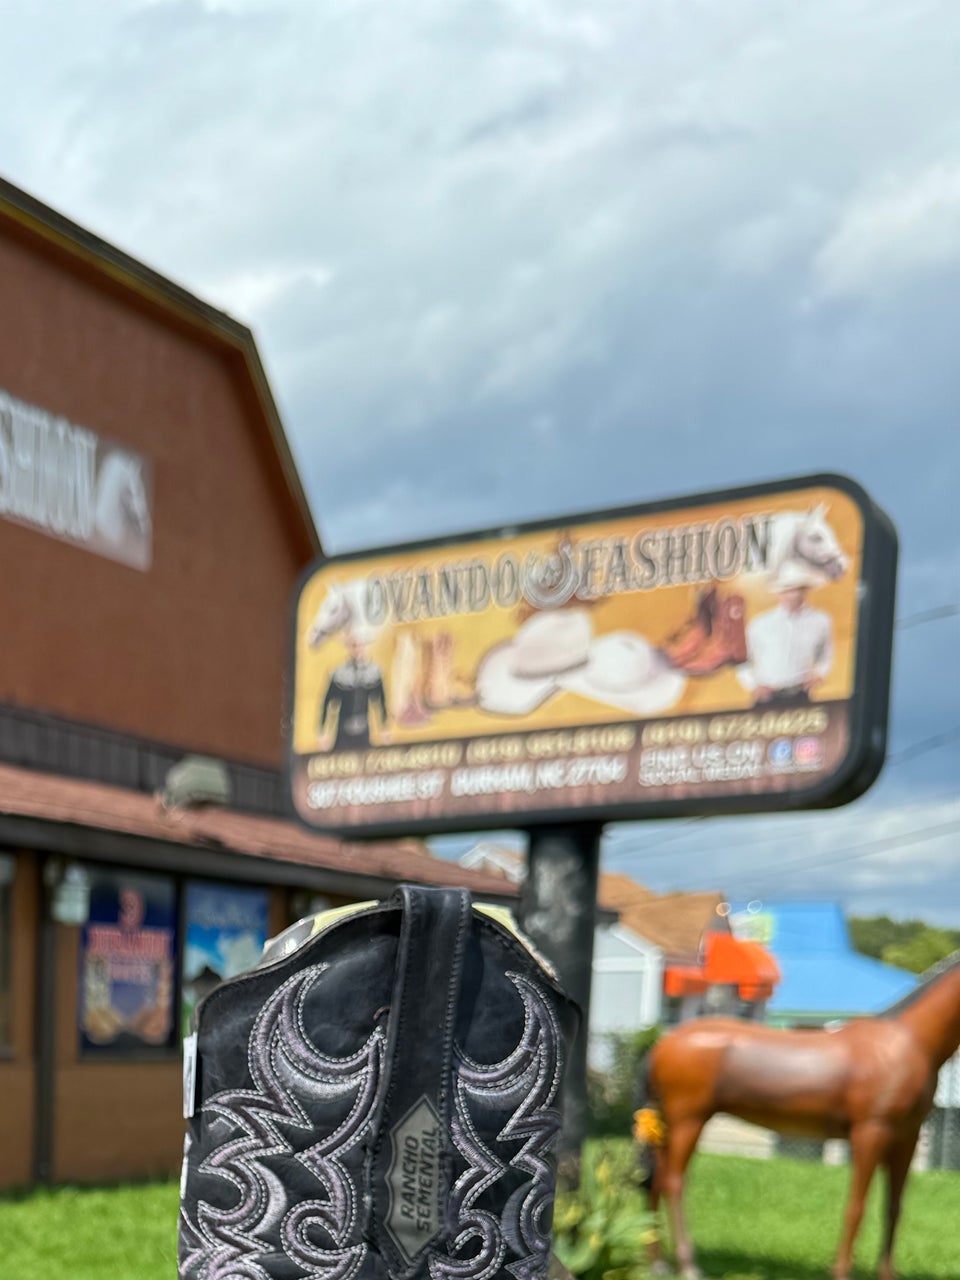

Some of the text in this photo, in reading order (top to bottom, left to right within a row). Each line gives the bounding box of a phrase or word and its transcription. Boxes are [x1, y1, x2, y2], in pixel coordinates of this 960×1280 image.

[365, 516, 774, 627] OVANDO FASHION
[401, 1135, 419, 1219] RANCHO
[416, 1126, 438, 1233] SEMENTAL
